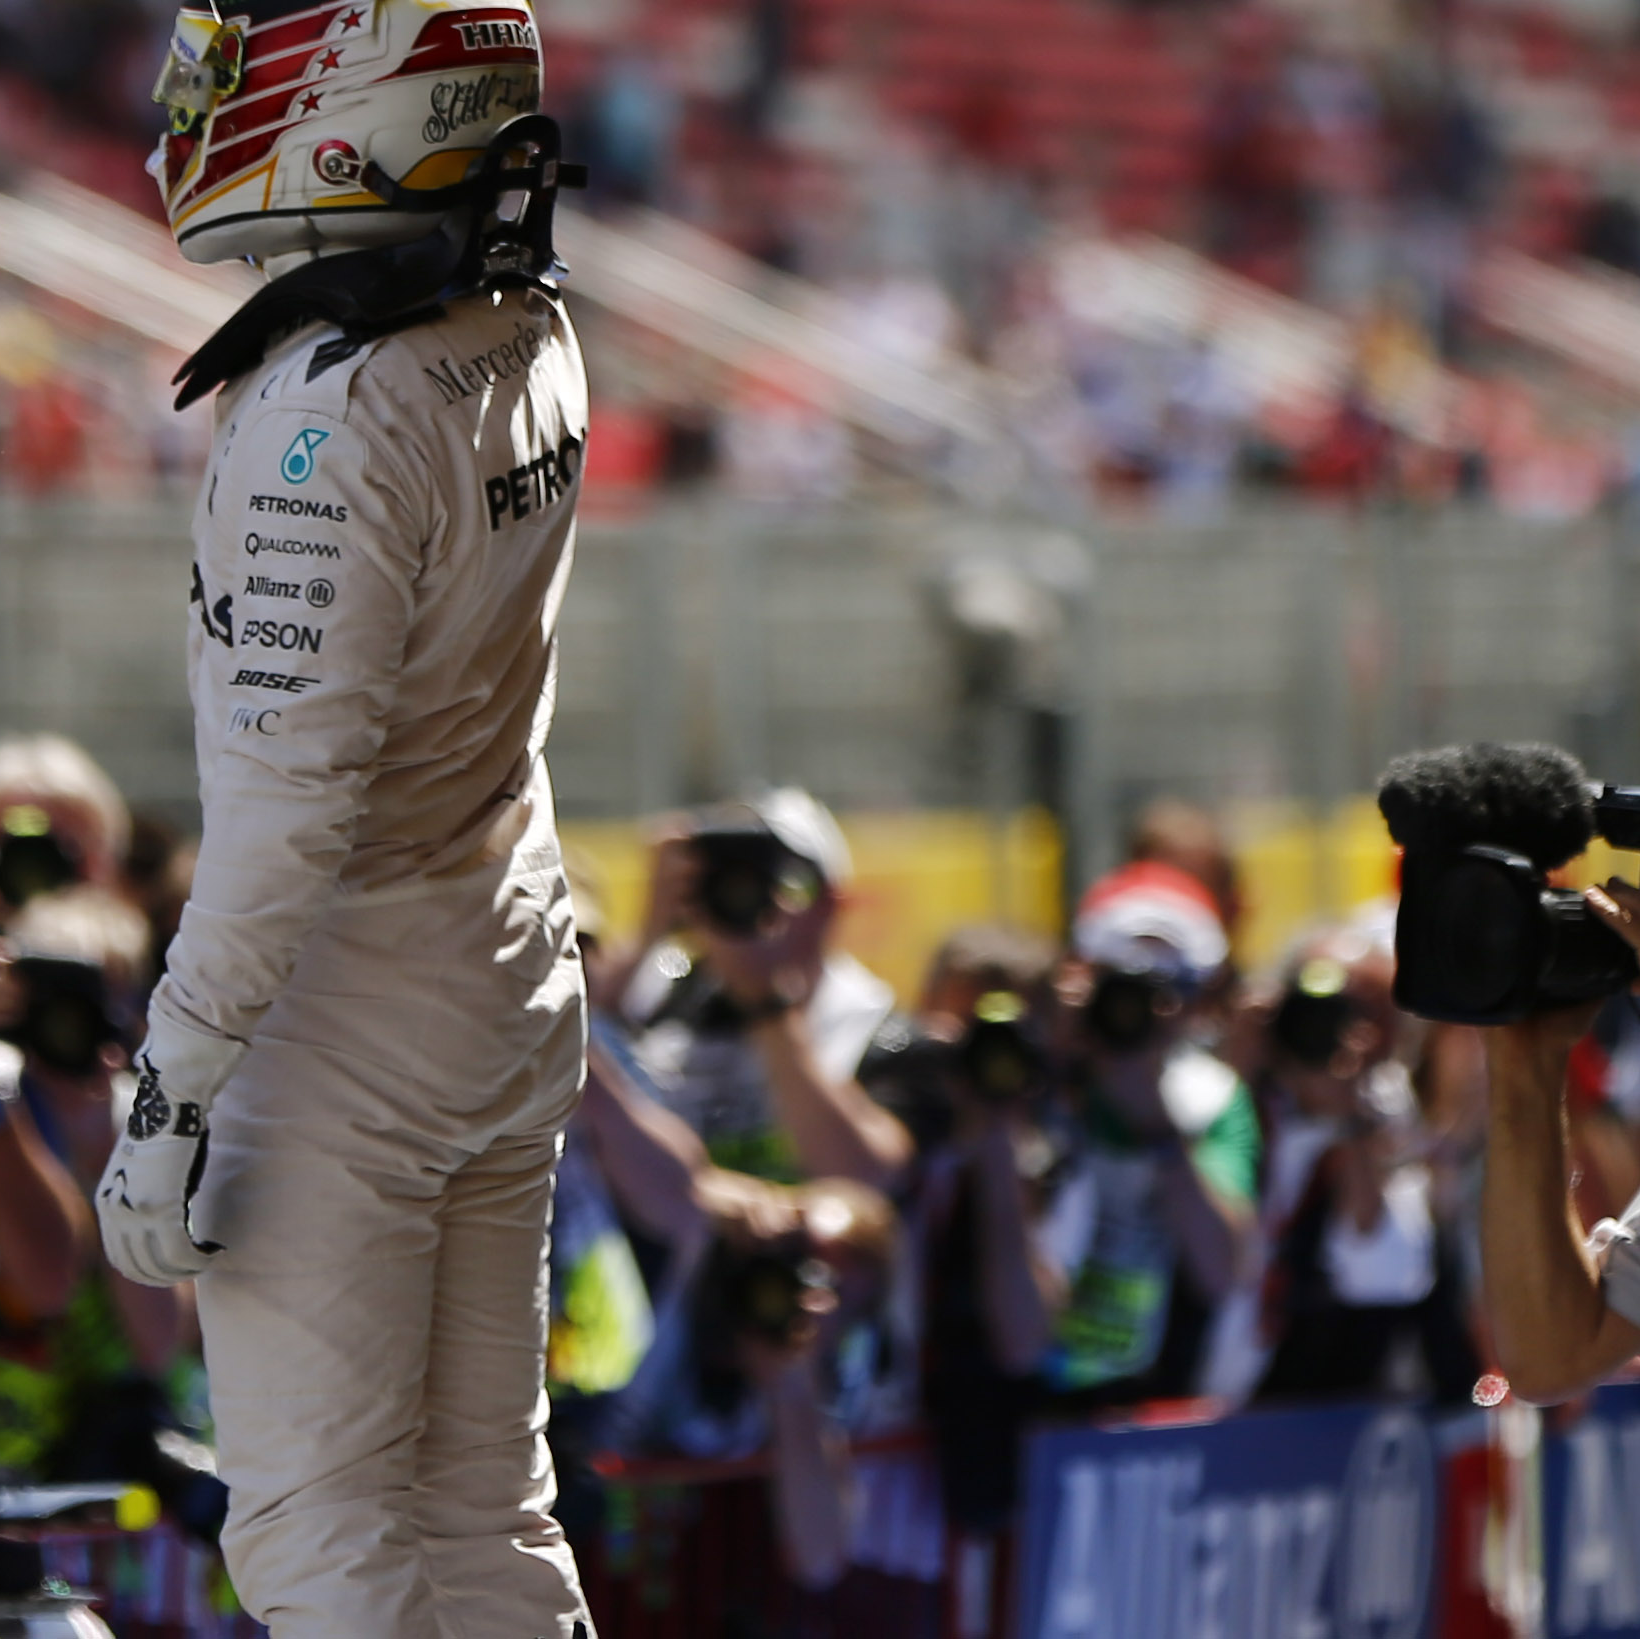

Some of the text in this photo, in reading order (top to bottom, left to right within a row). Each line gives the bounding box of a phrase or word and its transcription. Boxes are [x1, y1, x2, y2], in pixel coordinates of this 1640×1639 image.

[422, 71, 498, 144] Still
[424, 321, 547, 405] Mercede
[485, 426, 586, 532] PETRO
[248, 494, 348, 523] PETRONAS
[243, 576, 301, 599] Allianz
[240, 620, 323, 654] EPSON
[228, 669, 322, 694] BOSE
